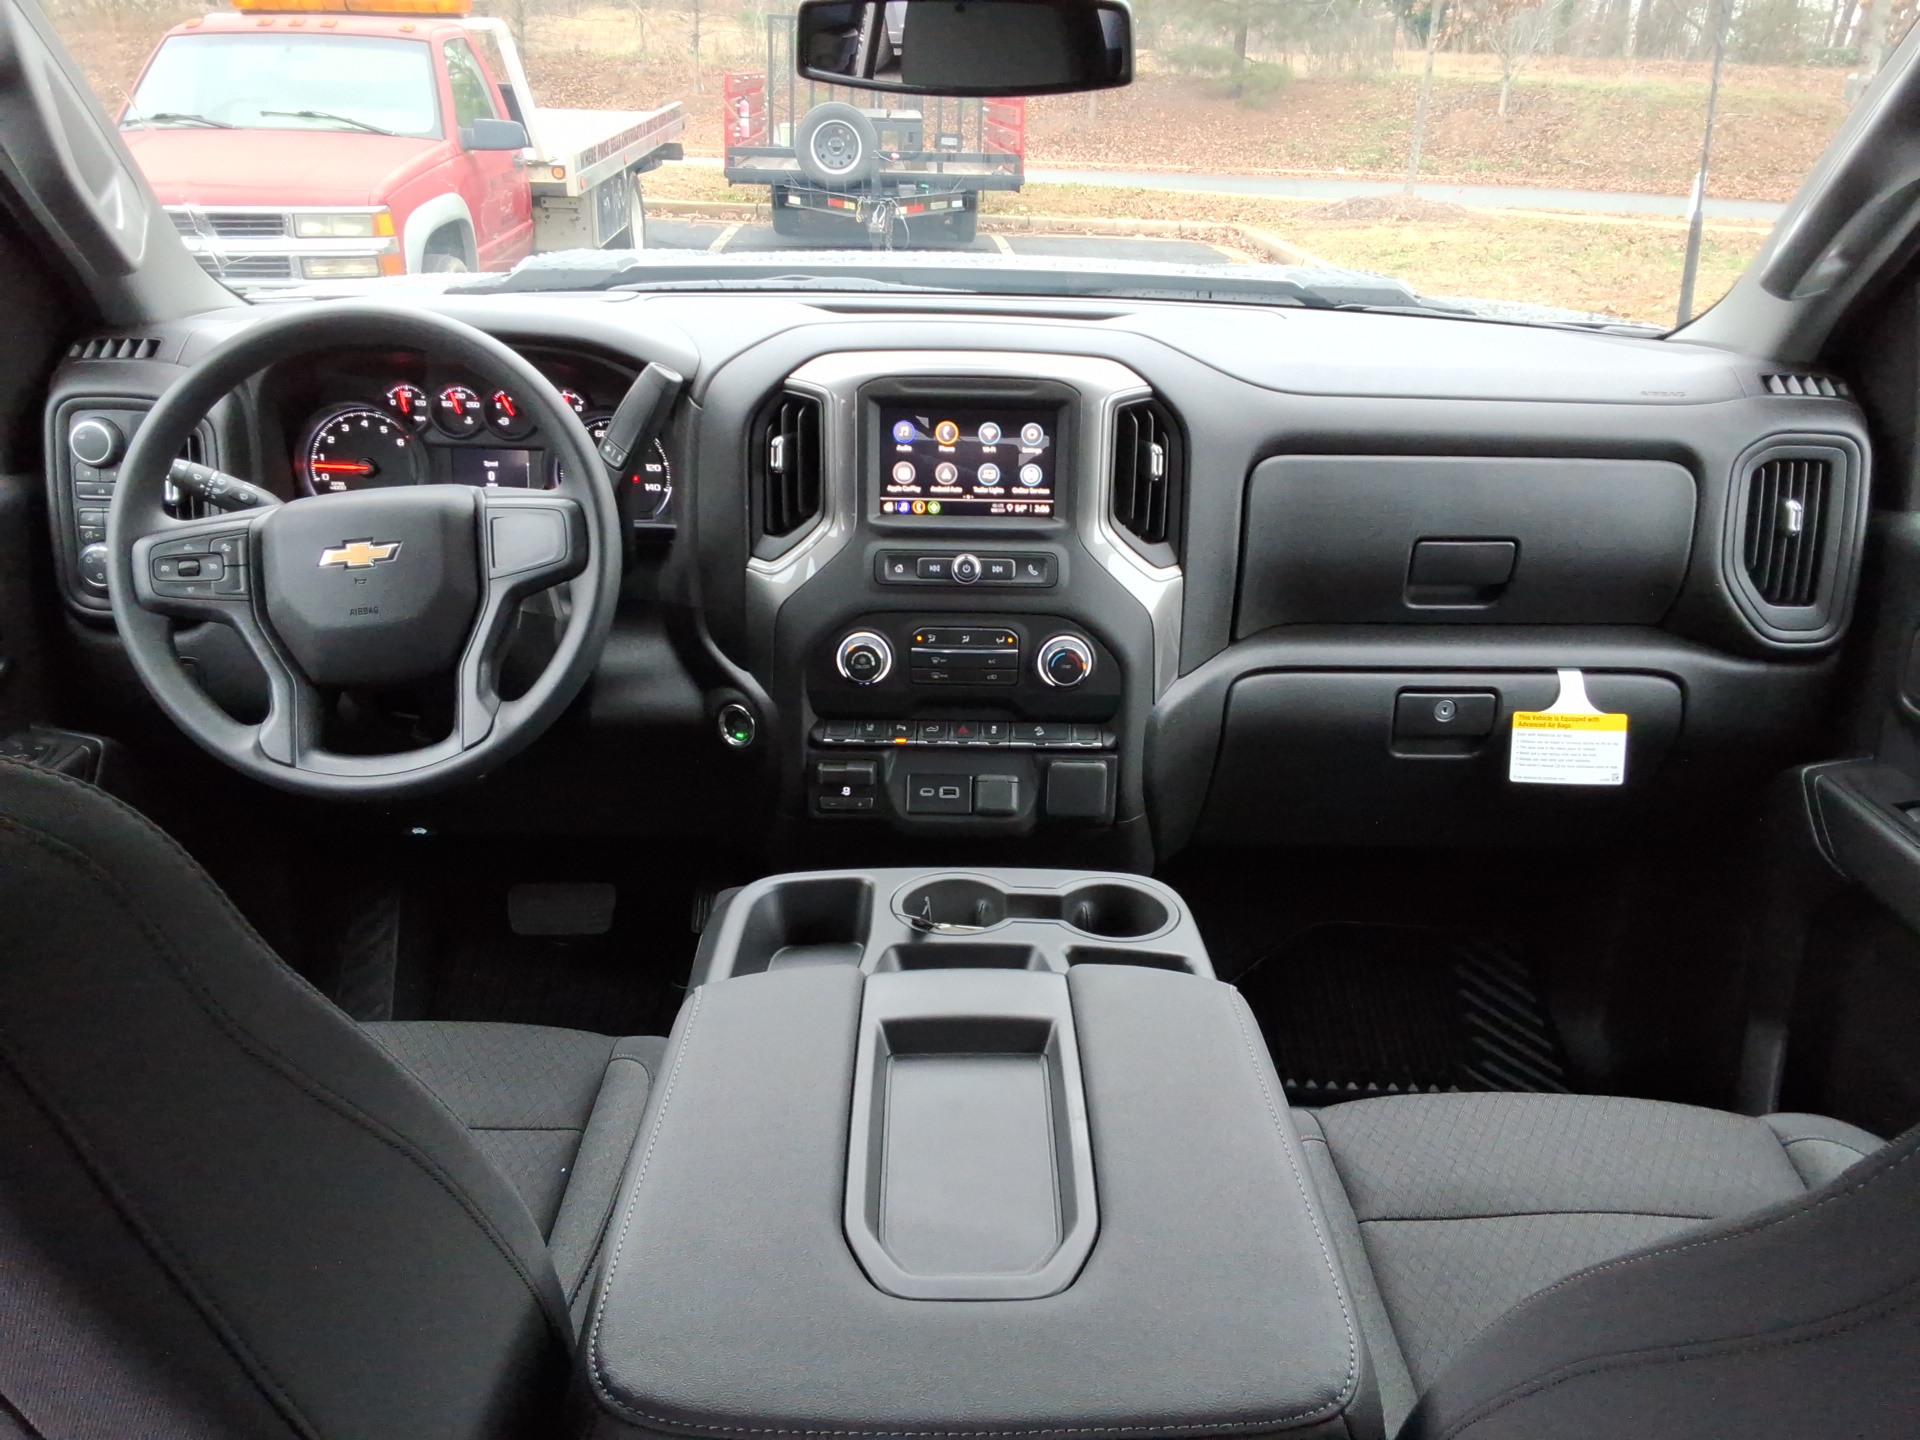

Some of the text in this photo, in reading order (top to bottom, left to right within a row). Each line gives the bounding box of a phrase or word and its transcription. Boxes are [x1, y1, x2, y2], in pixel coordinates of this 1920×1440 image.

[360, 419, 369, 427] 4
[341, 424, 350, 432] 3
[379, 425, 388, 434] 5
[327, 435, 335, 444] 2
[396, 438, 405, 446] 6
[319, 453, 325, 461] 1
[645, 463, 661, 472] 120
[321, 473, 330, 481] 0
[487, 470, 496, 481] 0
[645, 483, 661, 492] 140
[350, 606, 379, 616] AIRBAG
